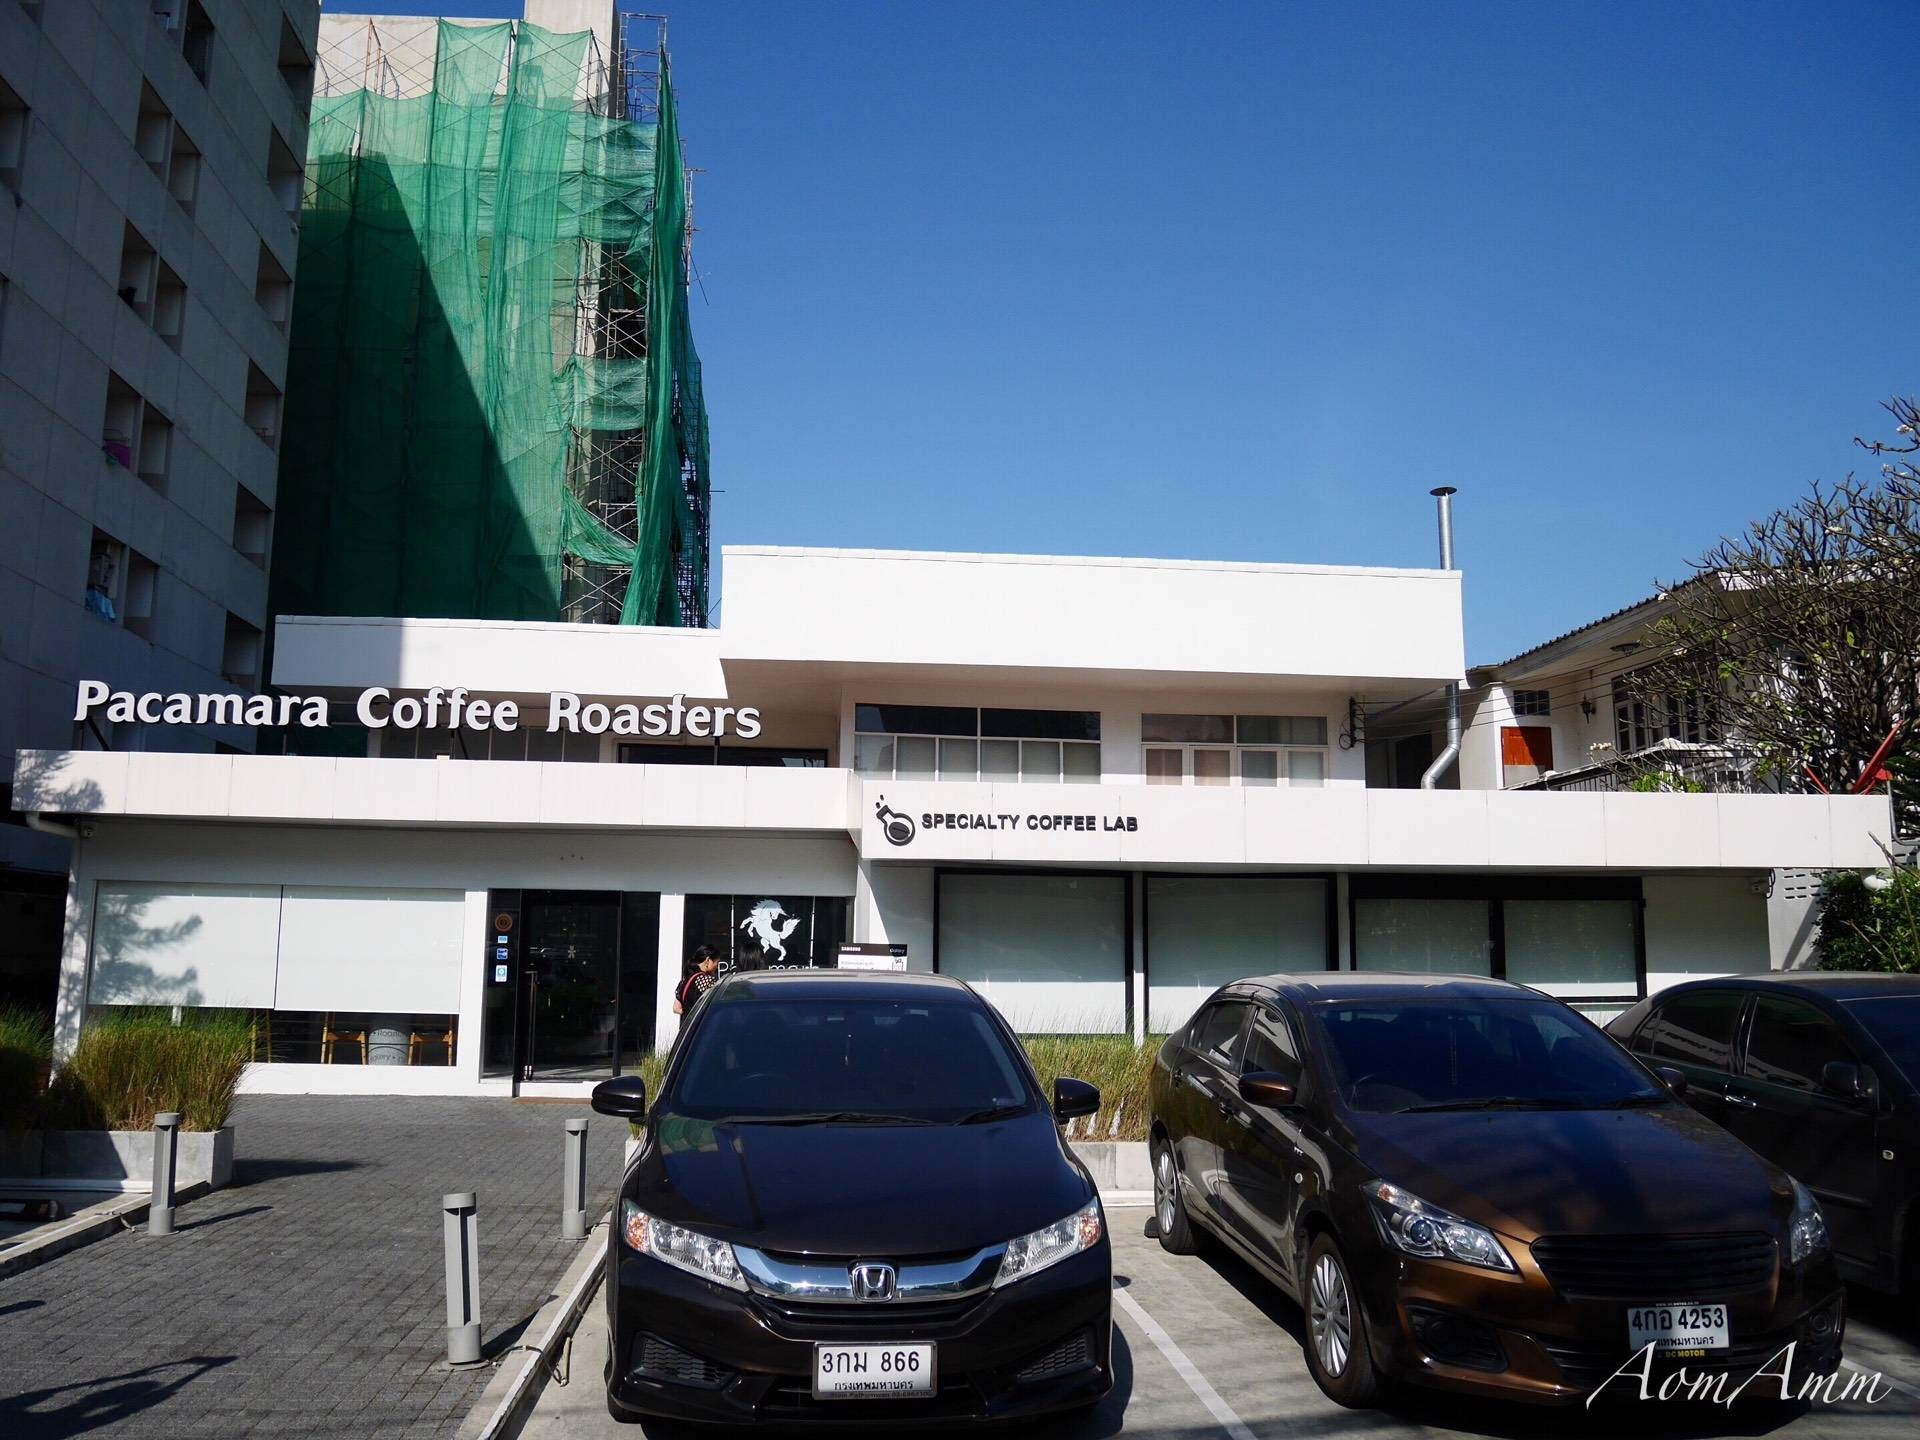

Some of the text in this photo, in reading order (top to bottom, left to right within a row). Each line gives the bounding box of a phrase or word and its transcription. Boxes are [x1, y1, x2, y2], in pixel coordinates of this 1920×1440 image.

[73, 680, 762, 739] Pacamara Coffee Roasters
[921, 813, 1138, 832] SPECIALTY COFFEE LAB
[1678, 1307, 1724, 1329] 4253
[822, 1351, 919, 1373] 3กม 866
[834, 1380, 914, 1391] กรงเทพมหานคร
